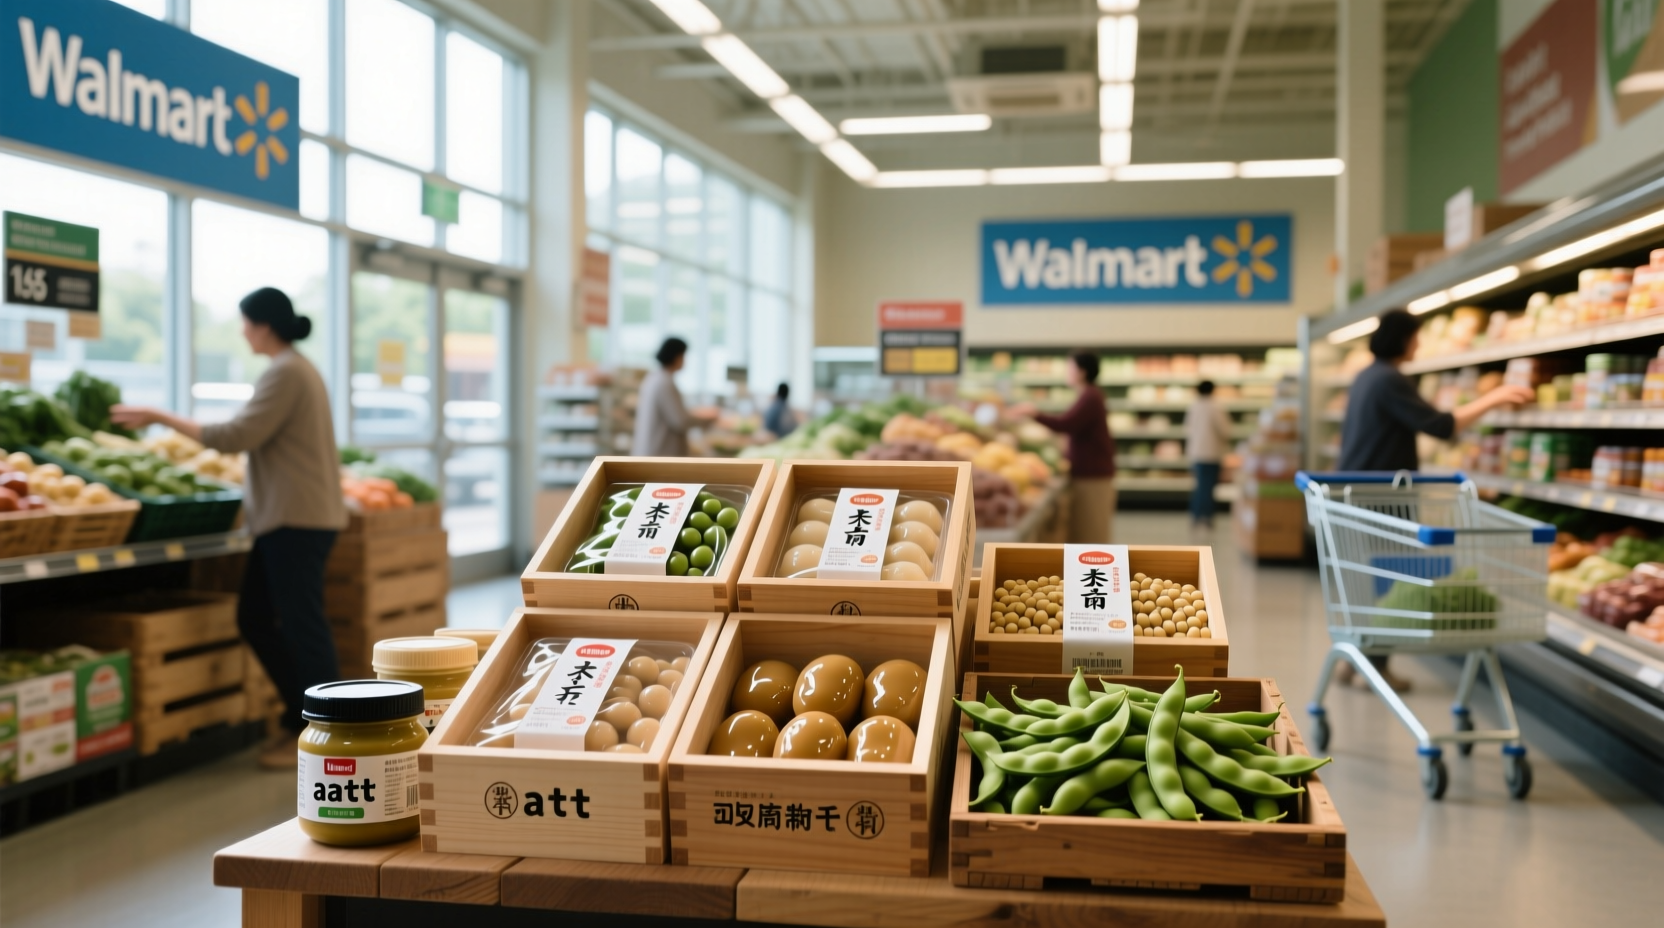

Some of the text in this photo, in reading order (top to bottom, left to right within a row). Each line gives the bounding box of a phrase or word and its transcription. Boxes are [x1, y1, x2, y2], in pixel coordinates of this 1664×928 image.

[18, 16, 234, 157] Walmart
[993, 235, 1208, 291] Walmart
[313, 778, 376, 803] aatt
[523, 787, 590, 819] att
